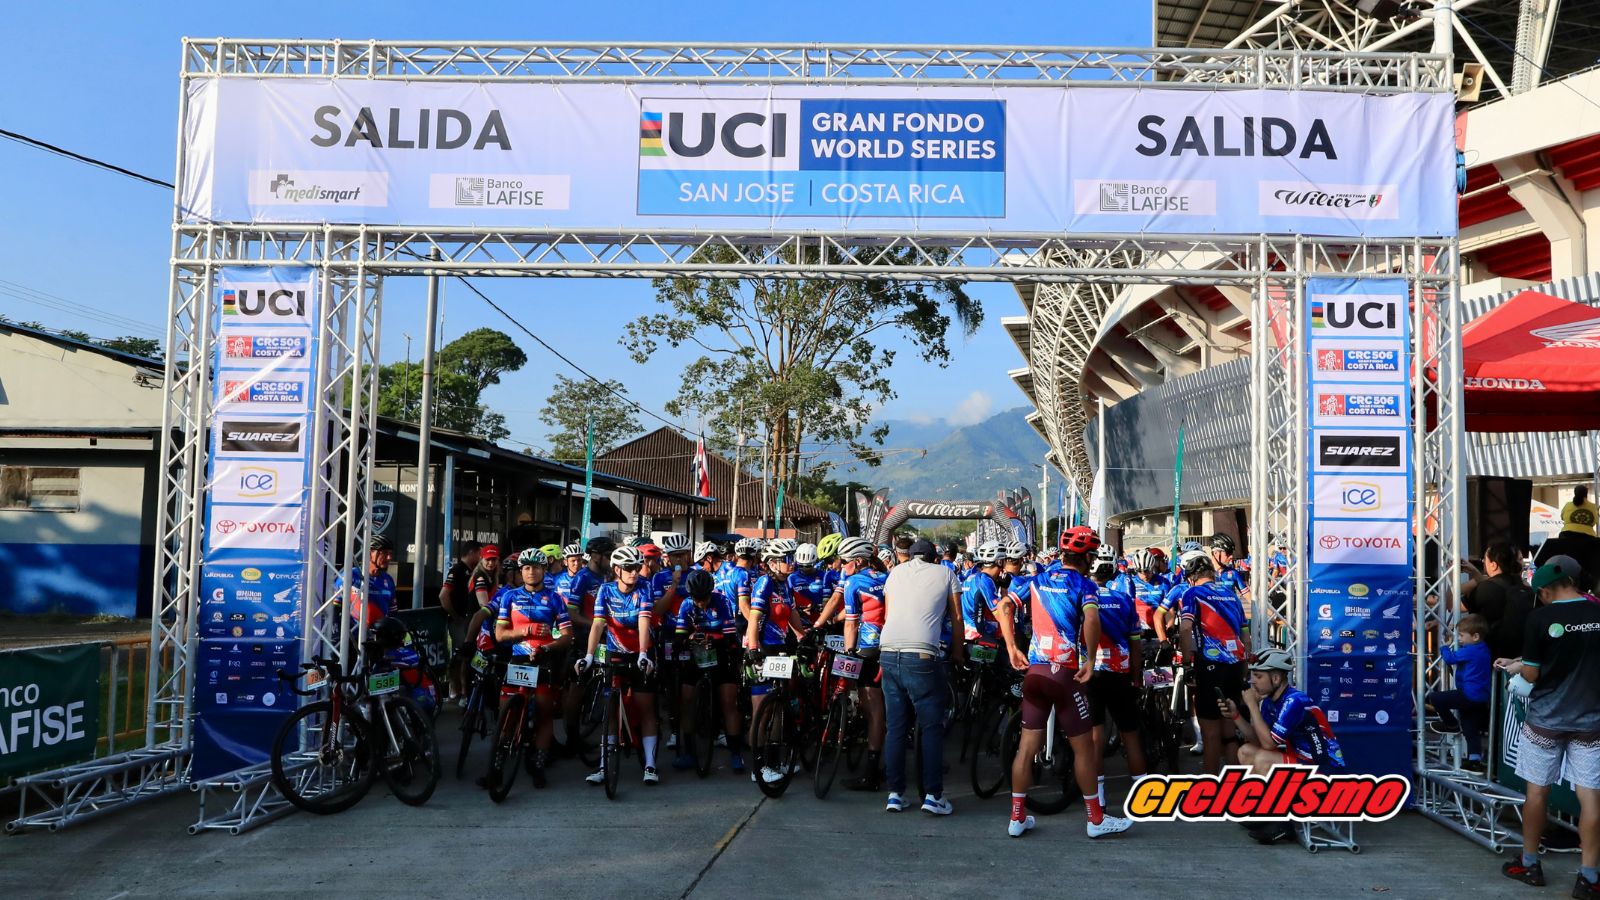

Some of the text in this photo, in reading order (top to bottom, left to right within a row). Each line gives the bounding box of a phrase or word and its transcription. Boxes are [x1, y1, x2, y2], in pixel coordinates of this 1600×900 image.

[311, 105, 512, 150] SALIDA
[812, 112, 985, 133] GRAN FONDO
[669, 112, 787, 158] UCI
[1135, 115, 1338, 160] SALIDA
[811, 138, 997, 160] WORLD SERIES
[487, 178, 523, 189] Banco
[1131, 184, 1168, 195] Banco
[284, 185, 361, 203] medismart
[486, 190, 544, 206] LAFISE
[679, 182, 795, 203] SAN JOSE
[821, 183, 965, 204] COSTA RICA
[1274, 189, 1366, 208] Wilier
[1131, 196, 1189, 211] LAFISE
[238, 289, 306, 316] UCI
[1326, 302, 1396, 329] UCI
[256, 337, 301, 346] CRC 506
[1348, 351, 1394, 360] CRC 506
[253, 382, 299, 391] CRC 506
[1465, 377, 1546, 390] HONDA
[1349, 396, 1395, 405] CRC 506
[226, 432, 296, 442] SUAREZ
[1325, 446, 1396, 456] SUAREZ
[240, 473, 273, 491] ice
[373, 483, 394, 493] LICIA
[1342, 487, 1376, 505] ice
[907, 502, 980, 517] Wilier
[239, 522, 296, 534] TOYOTA
[1343, 537, 1402, 549] TOYOTA
[769, 662, 787, 672] 088
[838, 661, 857, 673] 360
[375, 677, 395, 689] 535
[515, 671, 530, 681] 114
